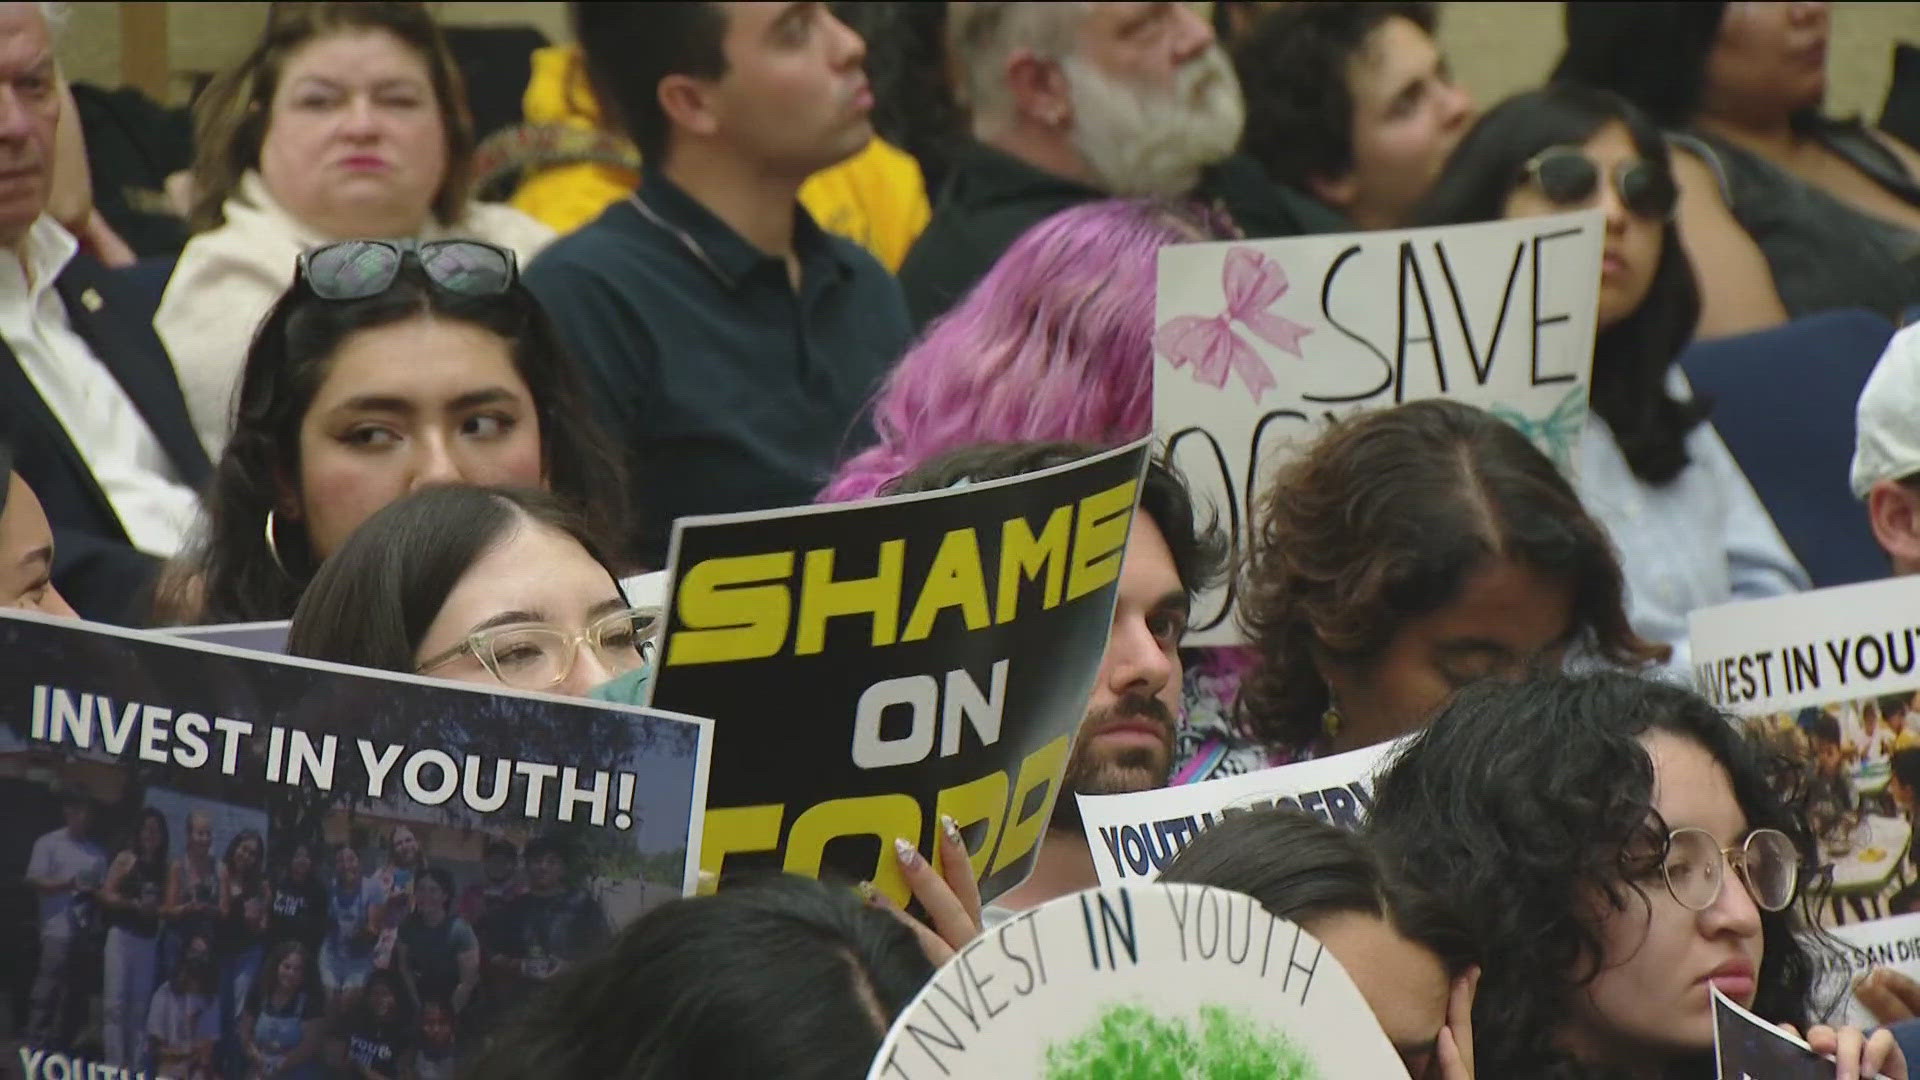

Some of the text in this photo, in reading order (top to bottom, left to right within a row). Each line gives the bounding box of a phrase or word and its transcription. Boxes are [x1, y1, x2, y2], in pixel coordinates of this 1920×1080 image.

[1302, 227, 1584, 404] SAVE
[666, 478, 1137, 667] SHAME
[851, 659, 1010, 770] ON
[1782, 643, 1820, 694] IN
[1826, 627, 1920, 686] YOU
[31, 685, 637, 831] INVEST IN YOUTH!
[1080, 885, 1138, 972] IN
[1163, 883, 1326, 1006] YOUTH
